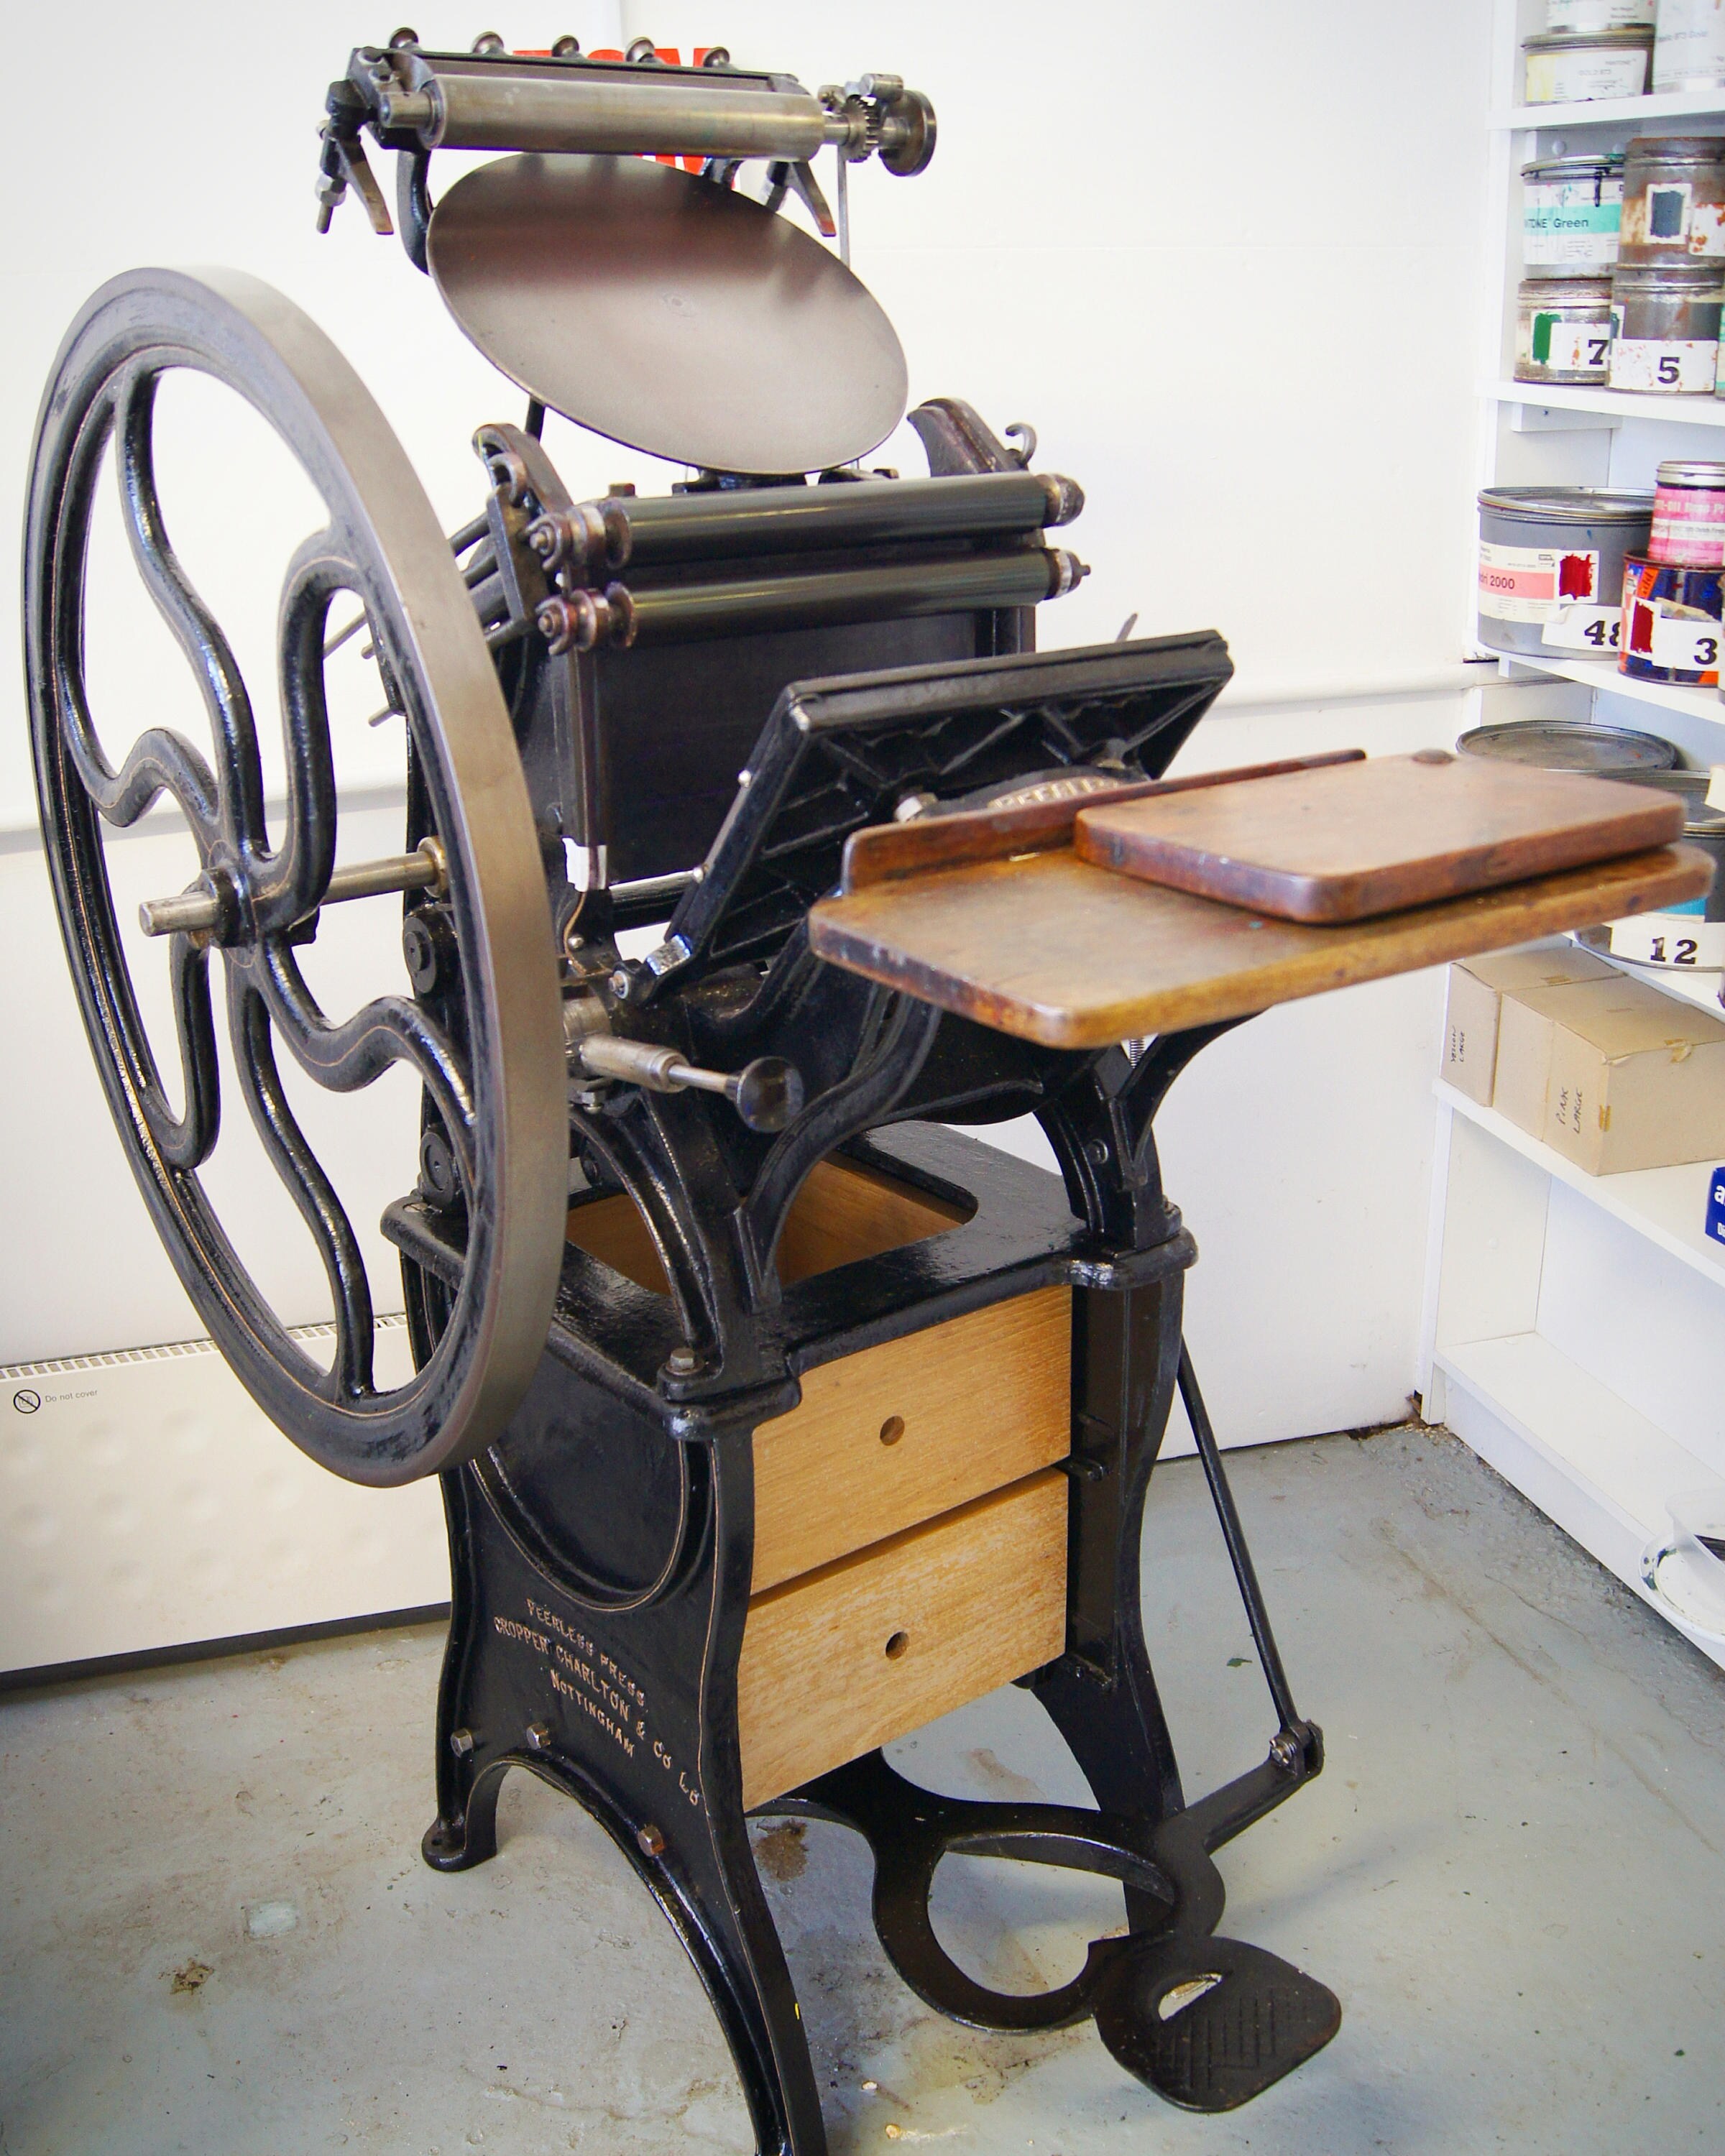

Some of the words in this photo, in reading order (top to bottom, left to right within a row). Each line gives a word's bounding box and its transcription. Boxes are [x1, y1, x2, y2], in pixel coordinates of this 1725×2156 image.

[1553, 218, 1589, 229] Green
[1588, 339, 1609, 365] 7
[1657, 356, 1680, 384] 5
[1490, 575, 1515, 589] 2000
[1694, 638, 1718, 665] 3
[1650, 936, 1698, 964] 12
[1573, 1087, 1583, 1134] LARGE
[75, 1390, 97, 1399] cover
[526, 1598, 594, 1657] PEERLESS
[600, 1653, 645, 1706] PRESS
[494, 1616, 551, 1655] CROPPER
[556, 1644, 630, 1722] CHARLTON
[550, 1667, 634, 1758] NOTTINGHAM
